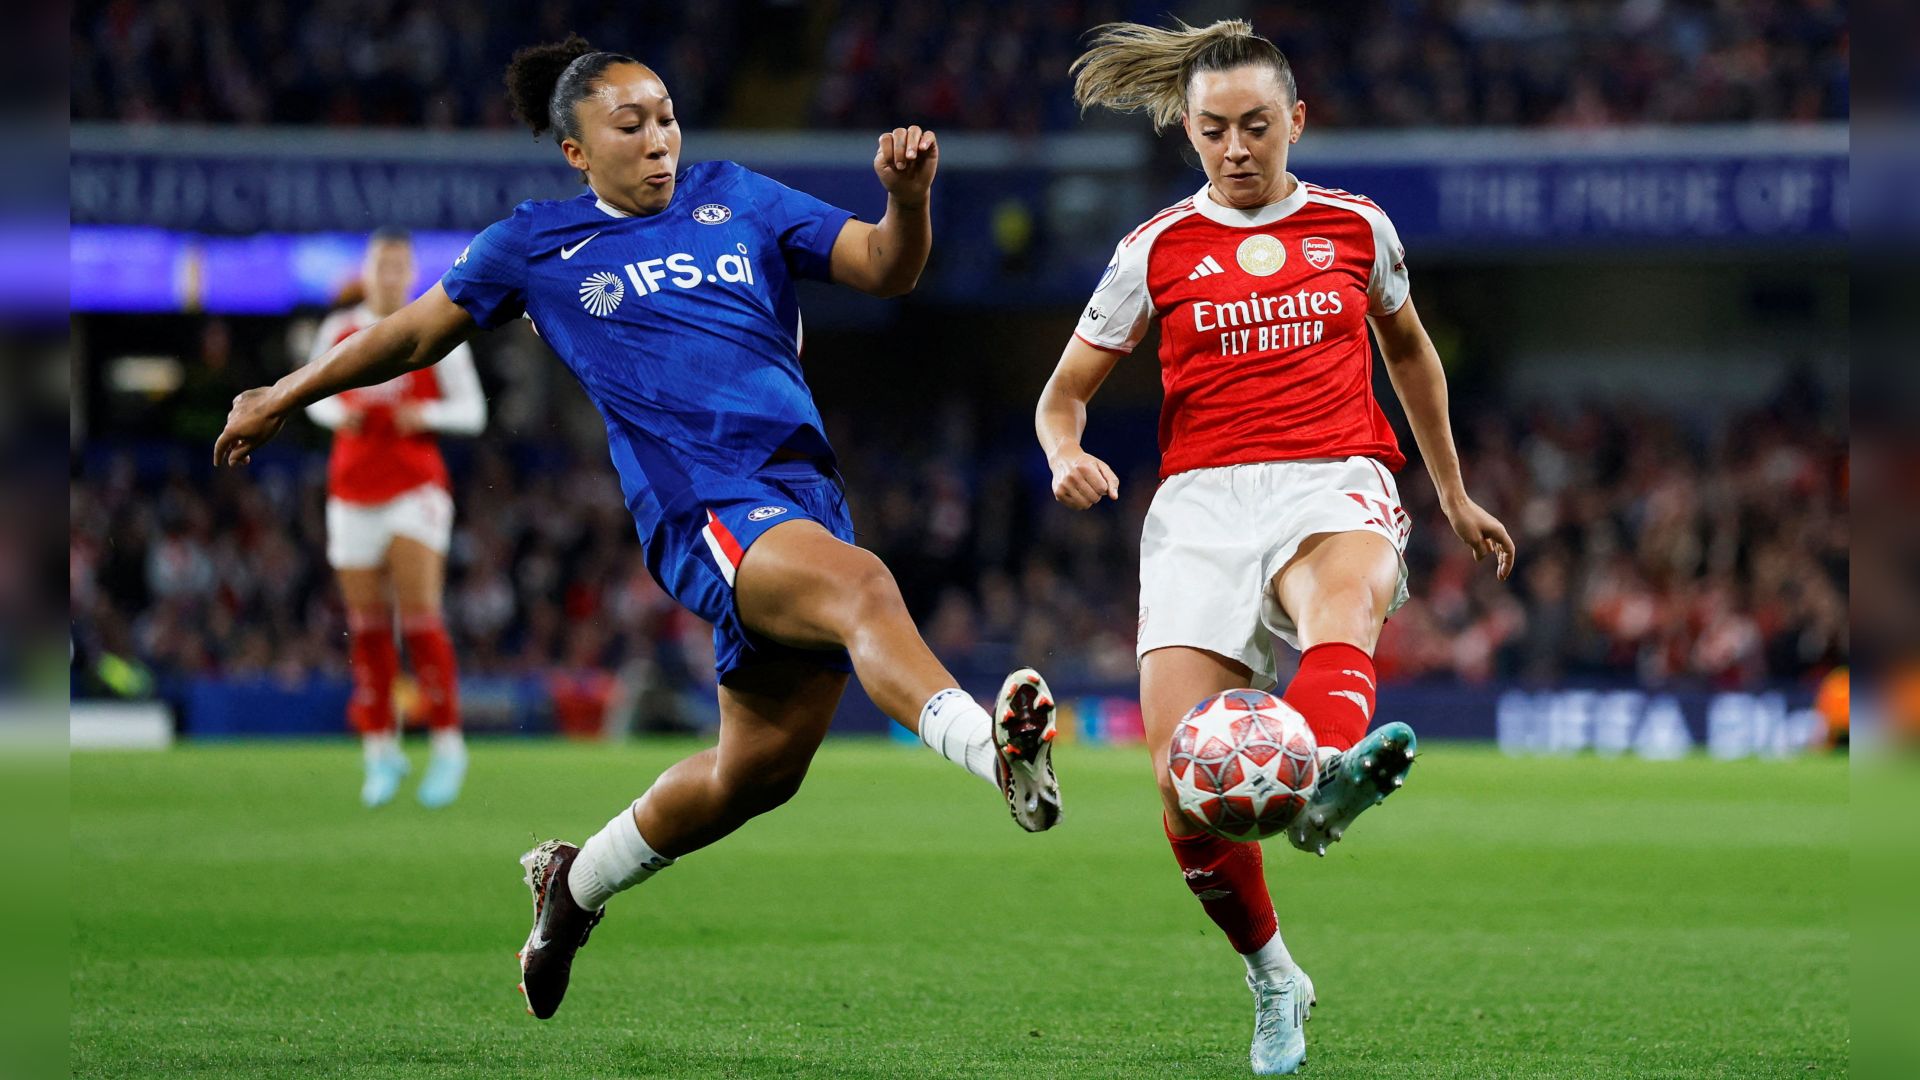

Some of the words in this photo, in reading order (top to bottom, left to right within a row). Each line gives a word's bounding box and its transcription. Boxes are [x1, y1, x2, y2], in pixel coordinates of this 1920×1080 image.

[624, 243, 753, 297] IFS.ai
[1193, 288, 1343, 332] Emirates
[1221, 329, 1250, 356] FLY
[1258, 320, 1324, 352] BETTER
[1496, 690, 1696, 760] UEFA
